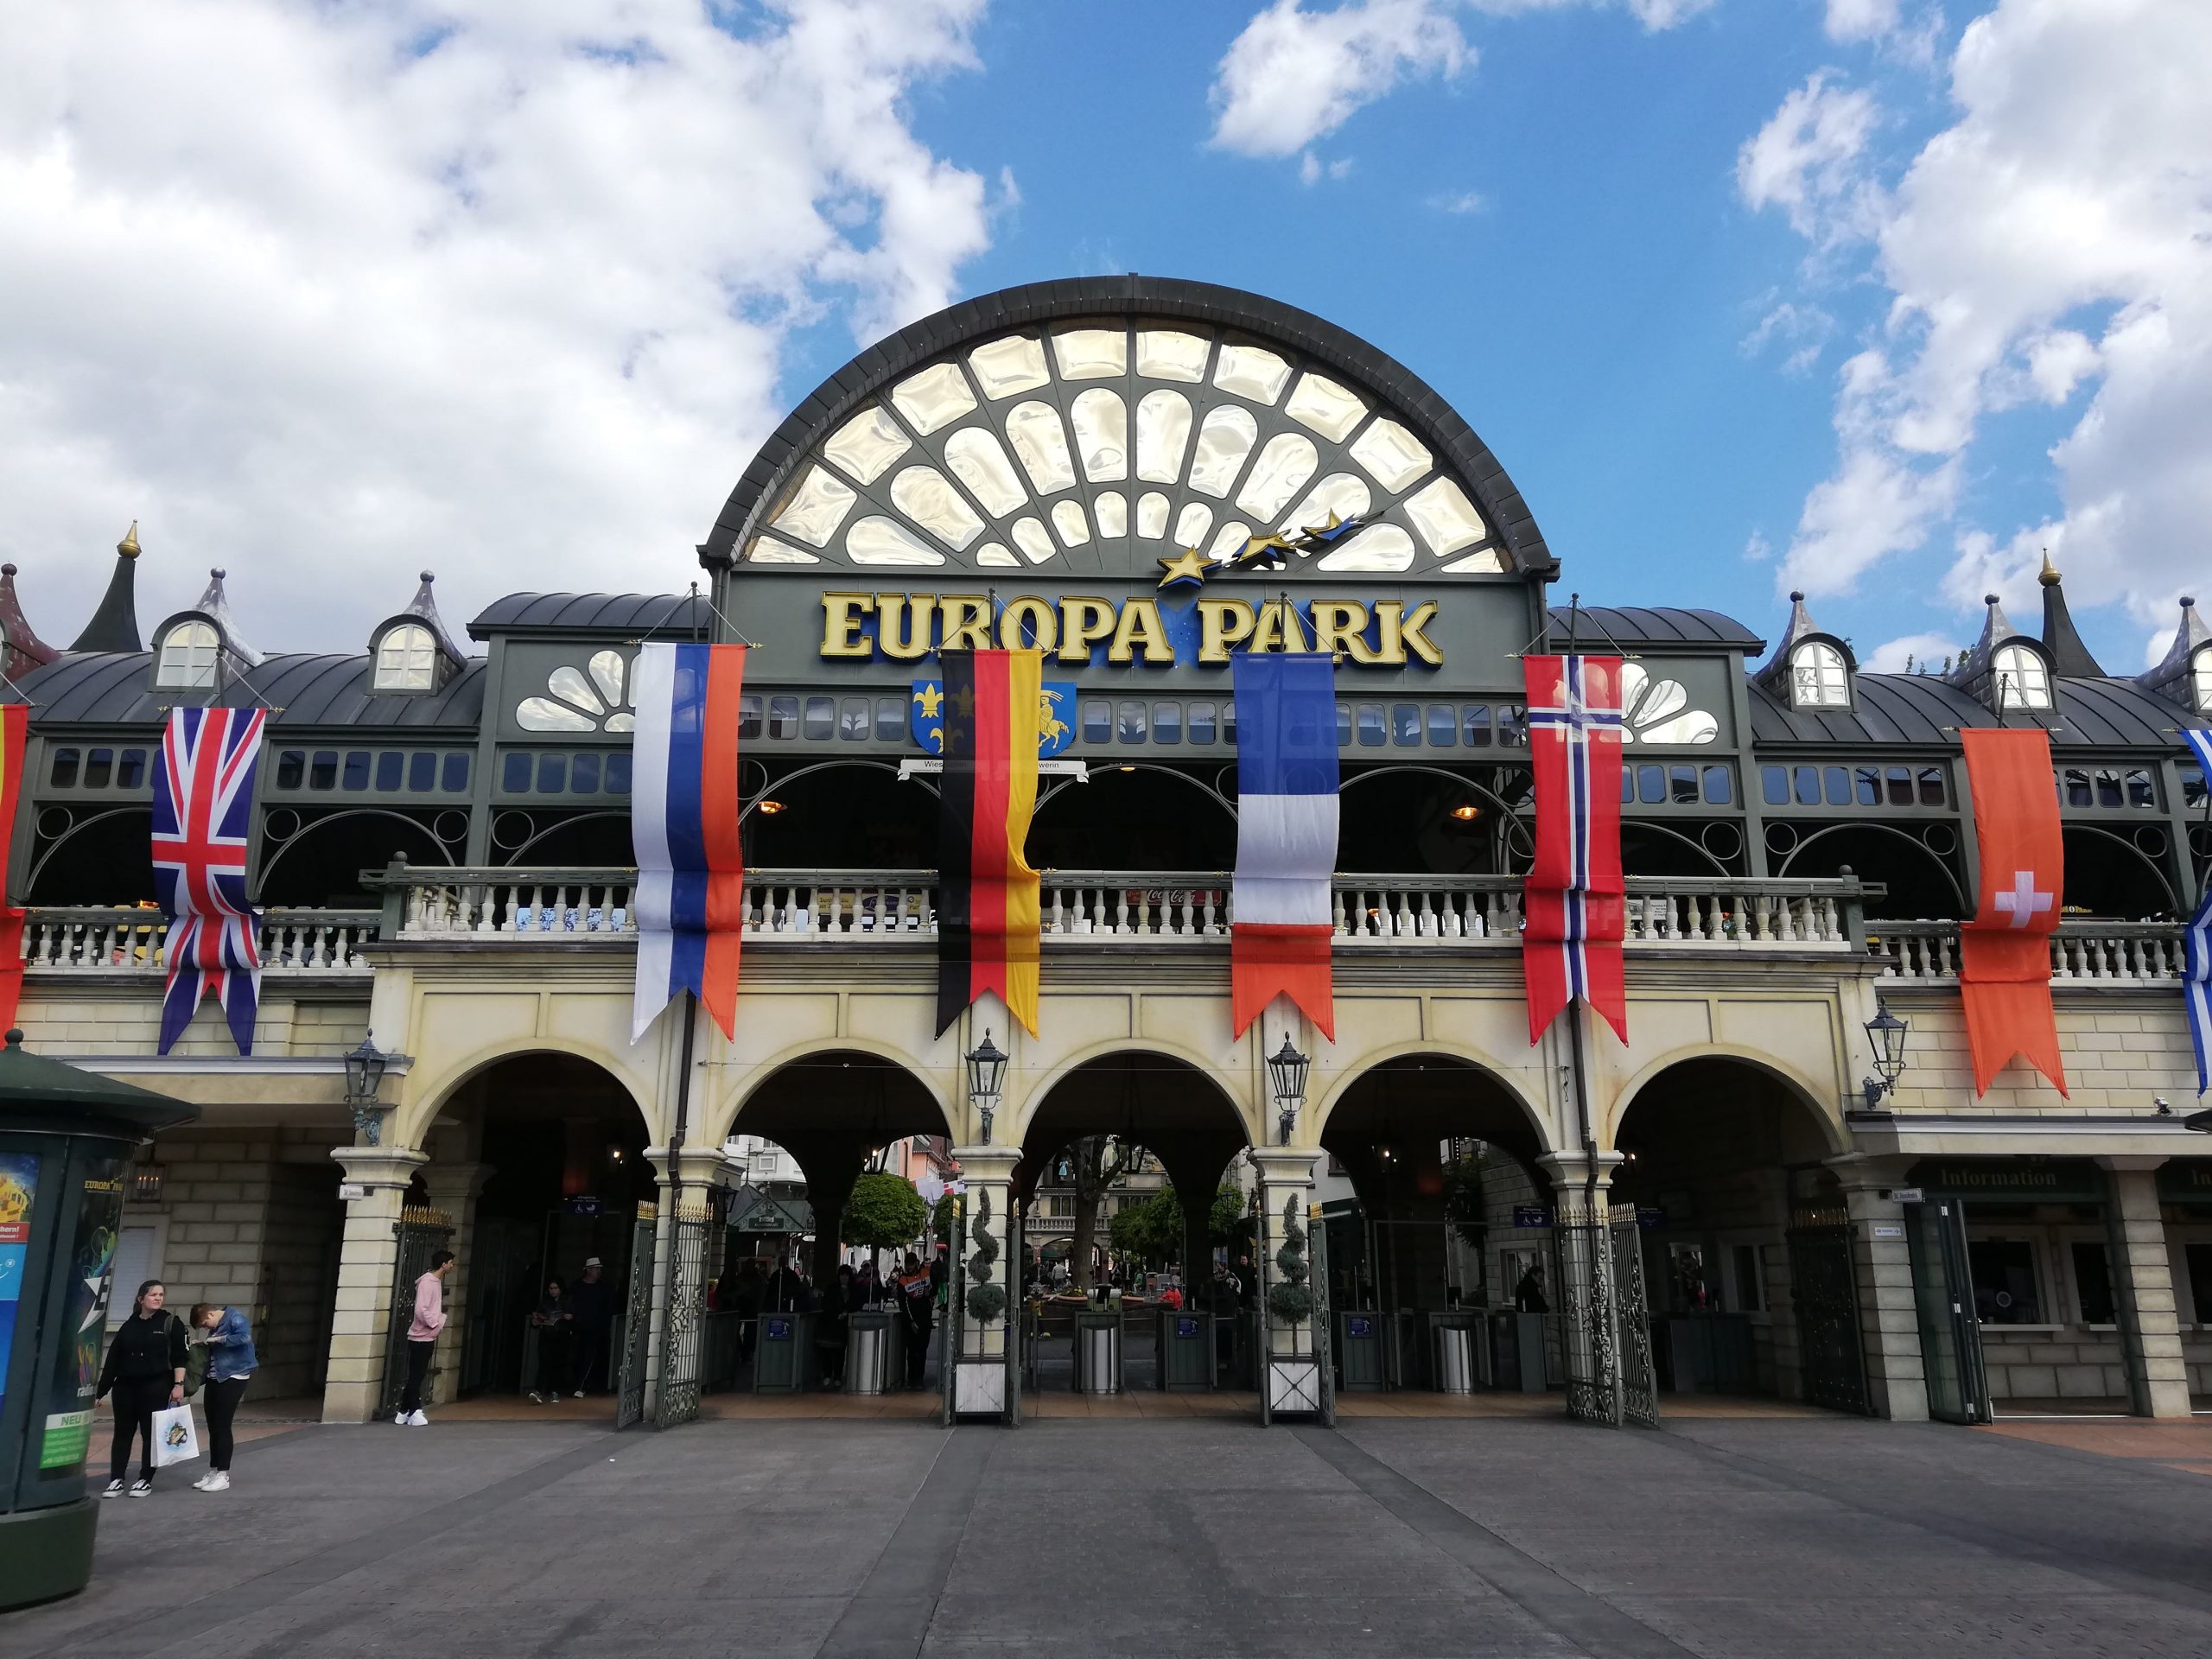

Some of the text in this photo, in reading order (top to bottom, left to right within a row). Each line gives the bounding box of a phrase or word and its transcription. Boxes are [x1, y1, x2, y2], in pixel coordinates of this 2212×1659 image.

[821, 591, 1444, 669] EUROPA PARK
[1147, 889, 1196, 903] Coc-Col
[1942, 1168, 2057, 1185] Information
[61, 1415, 82, 1426] NEU
